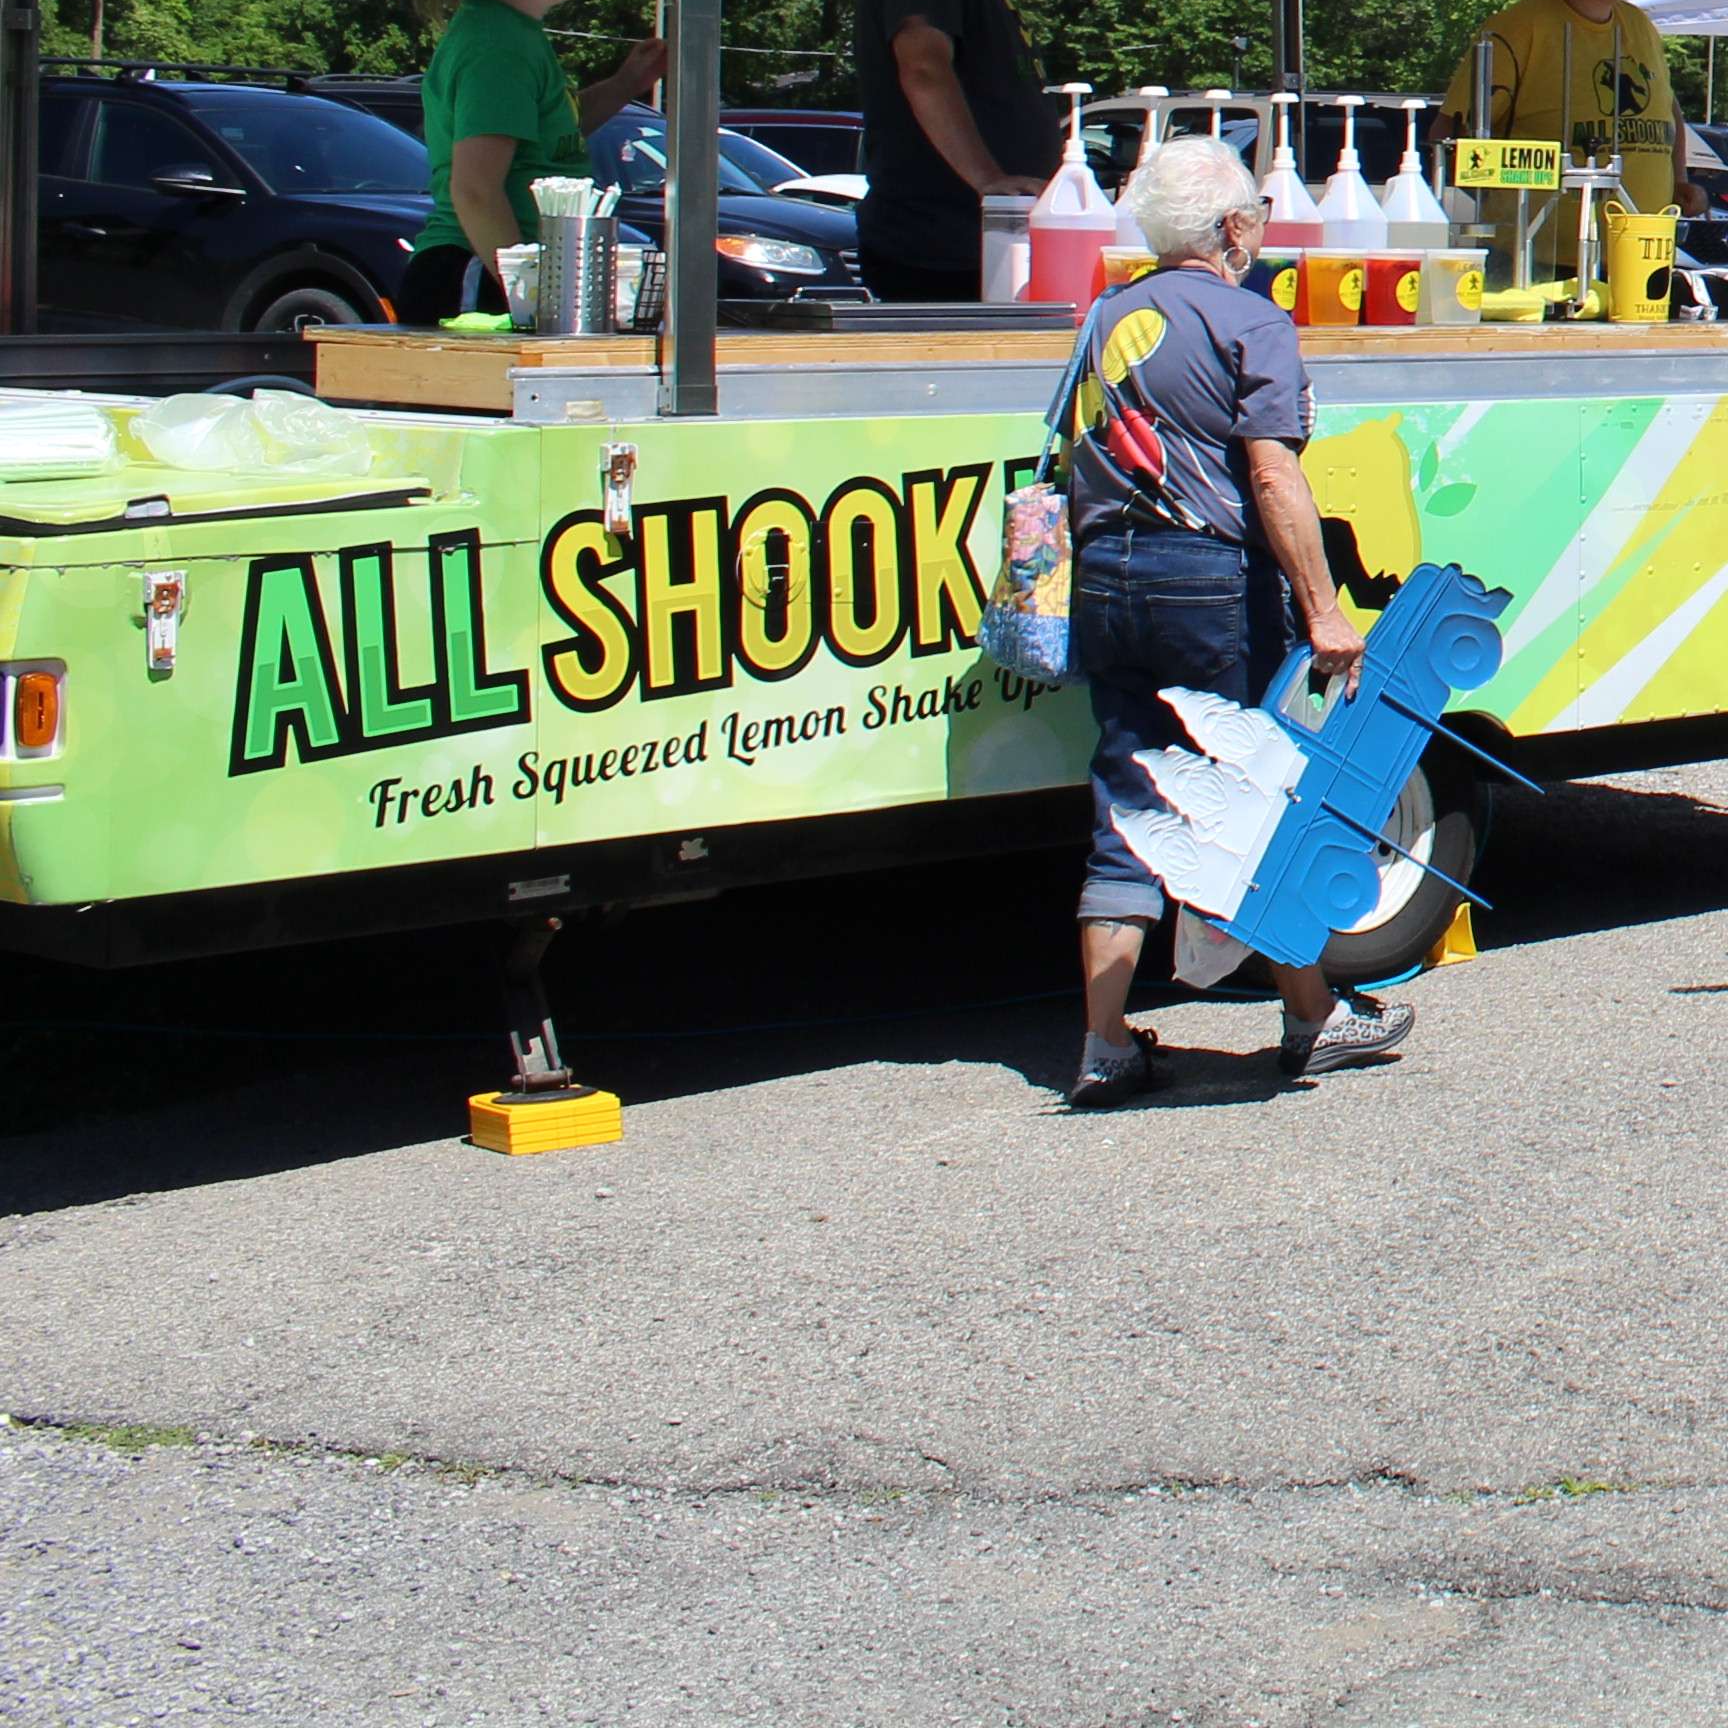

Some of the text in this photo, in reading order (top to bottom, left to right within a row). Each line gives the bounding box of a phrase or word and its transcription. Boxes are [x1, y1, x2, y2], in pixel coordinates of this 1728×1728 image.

[1617, 117, 1664, 145] SHOOK
[1501, 147, 1556, 170] LEMON
[1500, 169, 1533, 185] SHAKE
[1534, 170, 1554, 186] UPS
[228, 461, 995, 778] ALL SHOOK
[369, 667, 1063, 829] Fresh Squeezed Lemon Shake Up
